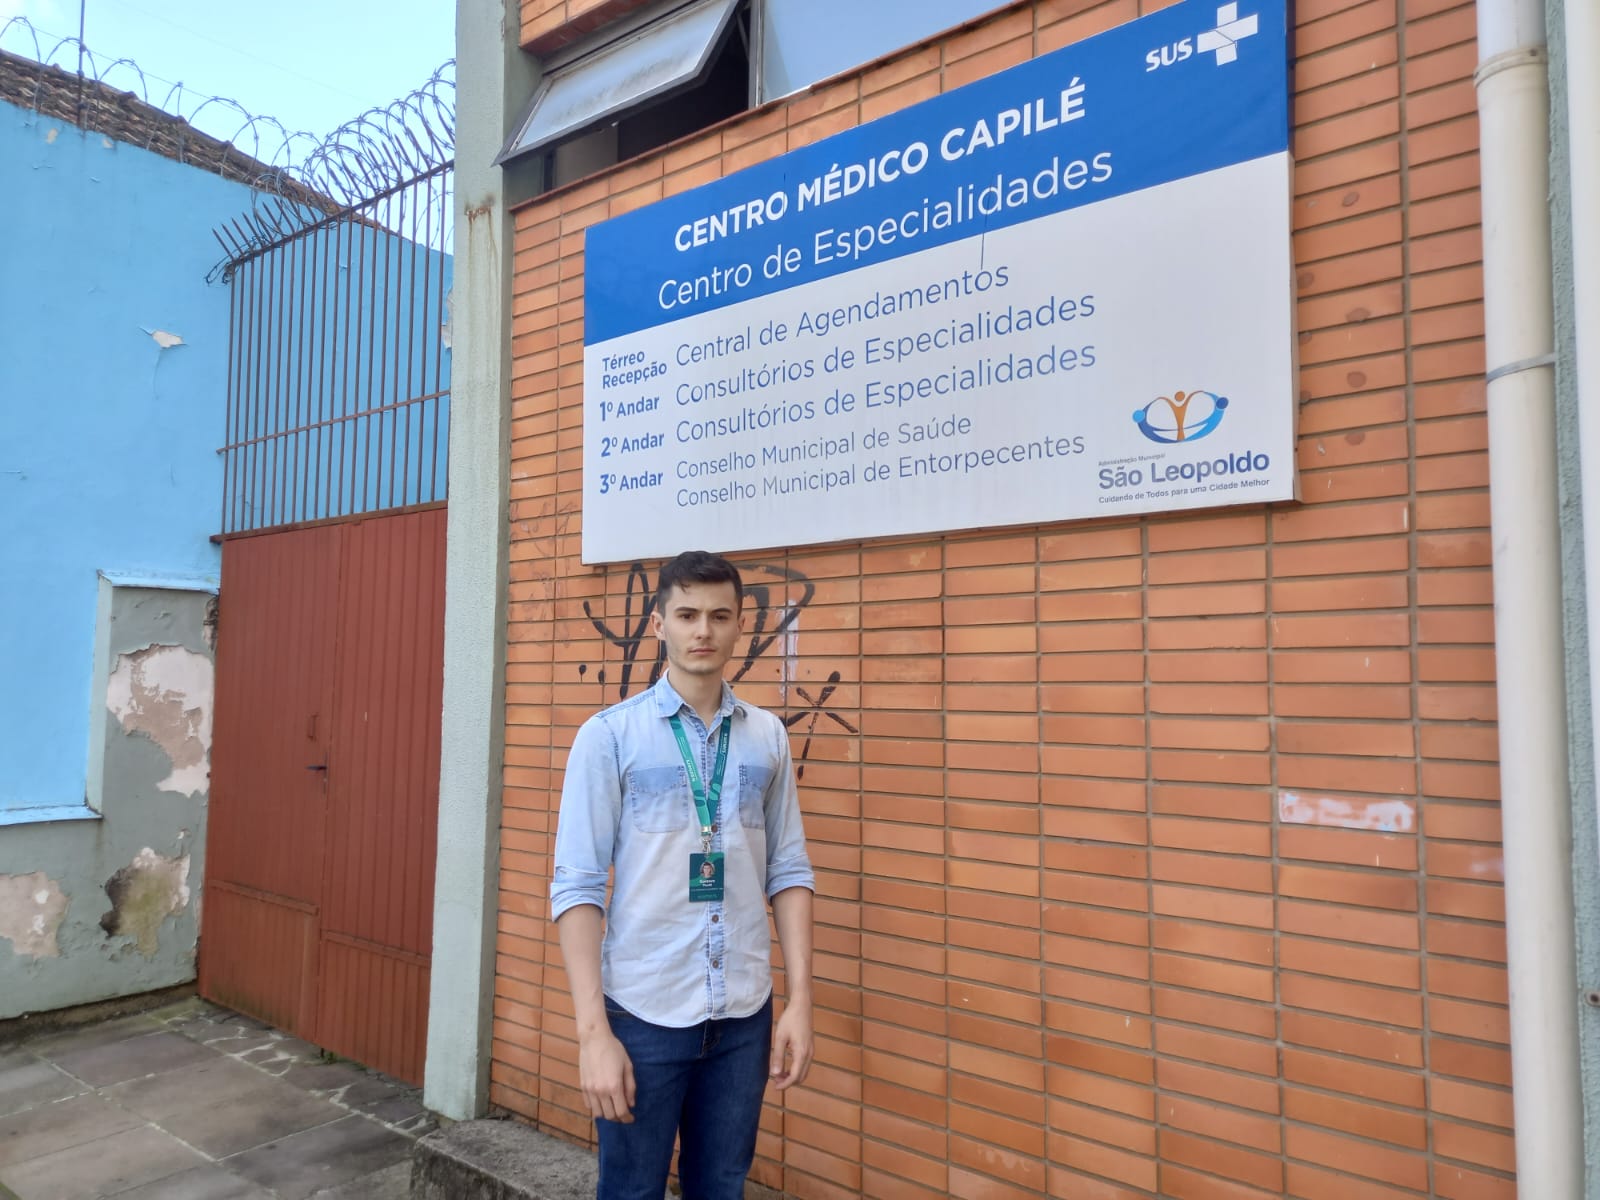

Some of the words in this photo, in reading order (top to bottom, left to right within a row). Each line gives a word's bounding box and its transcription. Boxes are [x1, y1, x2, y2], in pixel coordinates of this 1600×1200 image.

[1145, 37, 1192, 72] SUS
[673, 191, 789, 253] CENTRO
[797, 142, 929, 213] MÉDICO
[940, 77, 1086, 163] CAPILÉ
[658, 262, 752, 311] Centro
[762, 237, 802, 279] de
[814, 151, 1113, 265] Especialidades
[676, 326, 751, 367] Central
[759, 318, 788, 346] de
[796, 265, 1010, 337] Agendamentos
[602, 348, 645, 371] Térreo
[676, 357, 815, 407] Consultórios
[823, 344, 855, 371] de
[865, 293, 1096, 366] Especialidades
[602, 360, 667, 390] Recepção
[676, 400, 815, 445] Consultórios
[824, 387, 856, 416] de
[865, 342, 1096, 408] Especialidades
[616, 395, 660, 418] Andar
[621, 432, 665, 455] Andar
[676, 451, 756, 481] Conselho
[762, 431, 855, 467] Municipal
[863, 428, 889, 450] de
[898, 413, 972, 446] Saúde
[619, 470, 663, 492] Andar
[676, 482, 756, 507] Conselho
[762, 465, 856, 497] Municipal
[863, 462, 890, 482] de
[899, 434, 1085, 479] Entorpecentes
[1098, 465, 1143, 490] São
[1151, 450, 1270, 483] Leopoldo
[1098, 493, 1133, 503] Cuidando
[1134, 491, 1145, 500] de
[1146, 490, 1169, 499] Todos
[1171, 488, 1188, 497] para
[1190, 486, 1206, 494] uma
[1209, 481, 1238, 491] Cidade
[1241, 479, 1270, 488] Melhor
